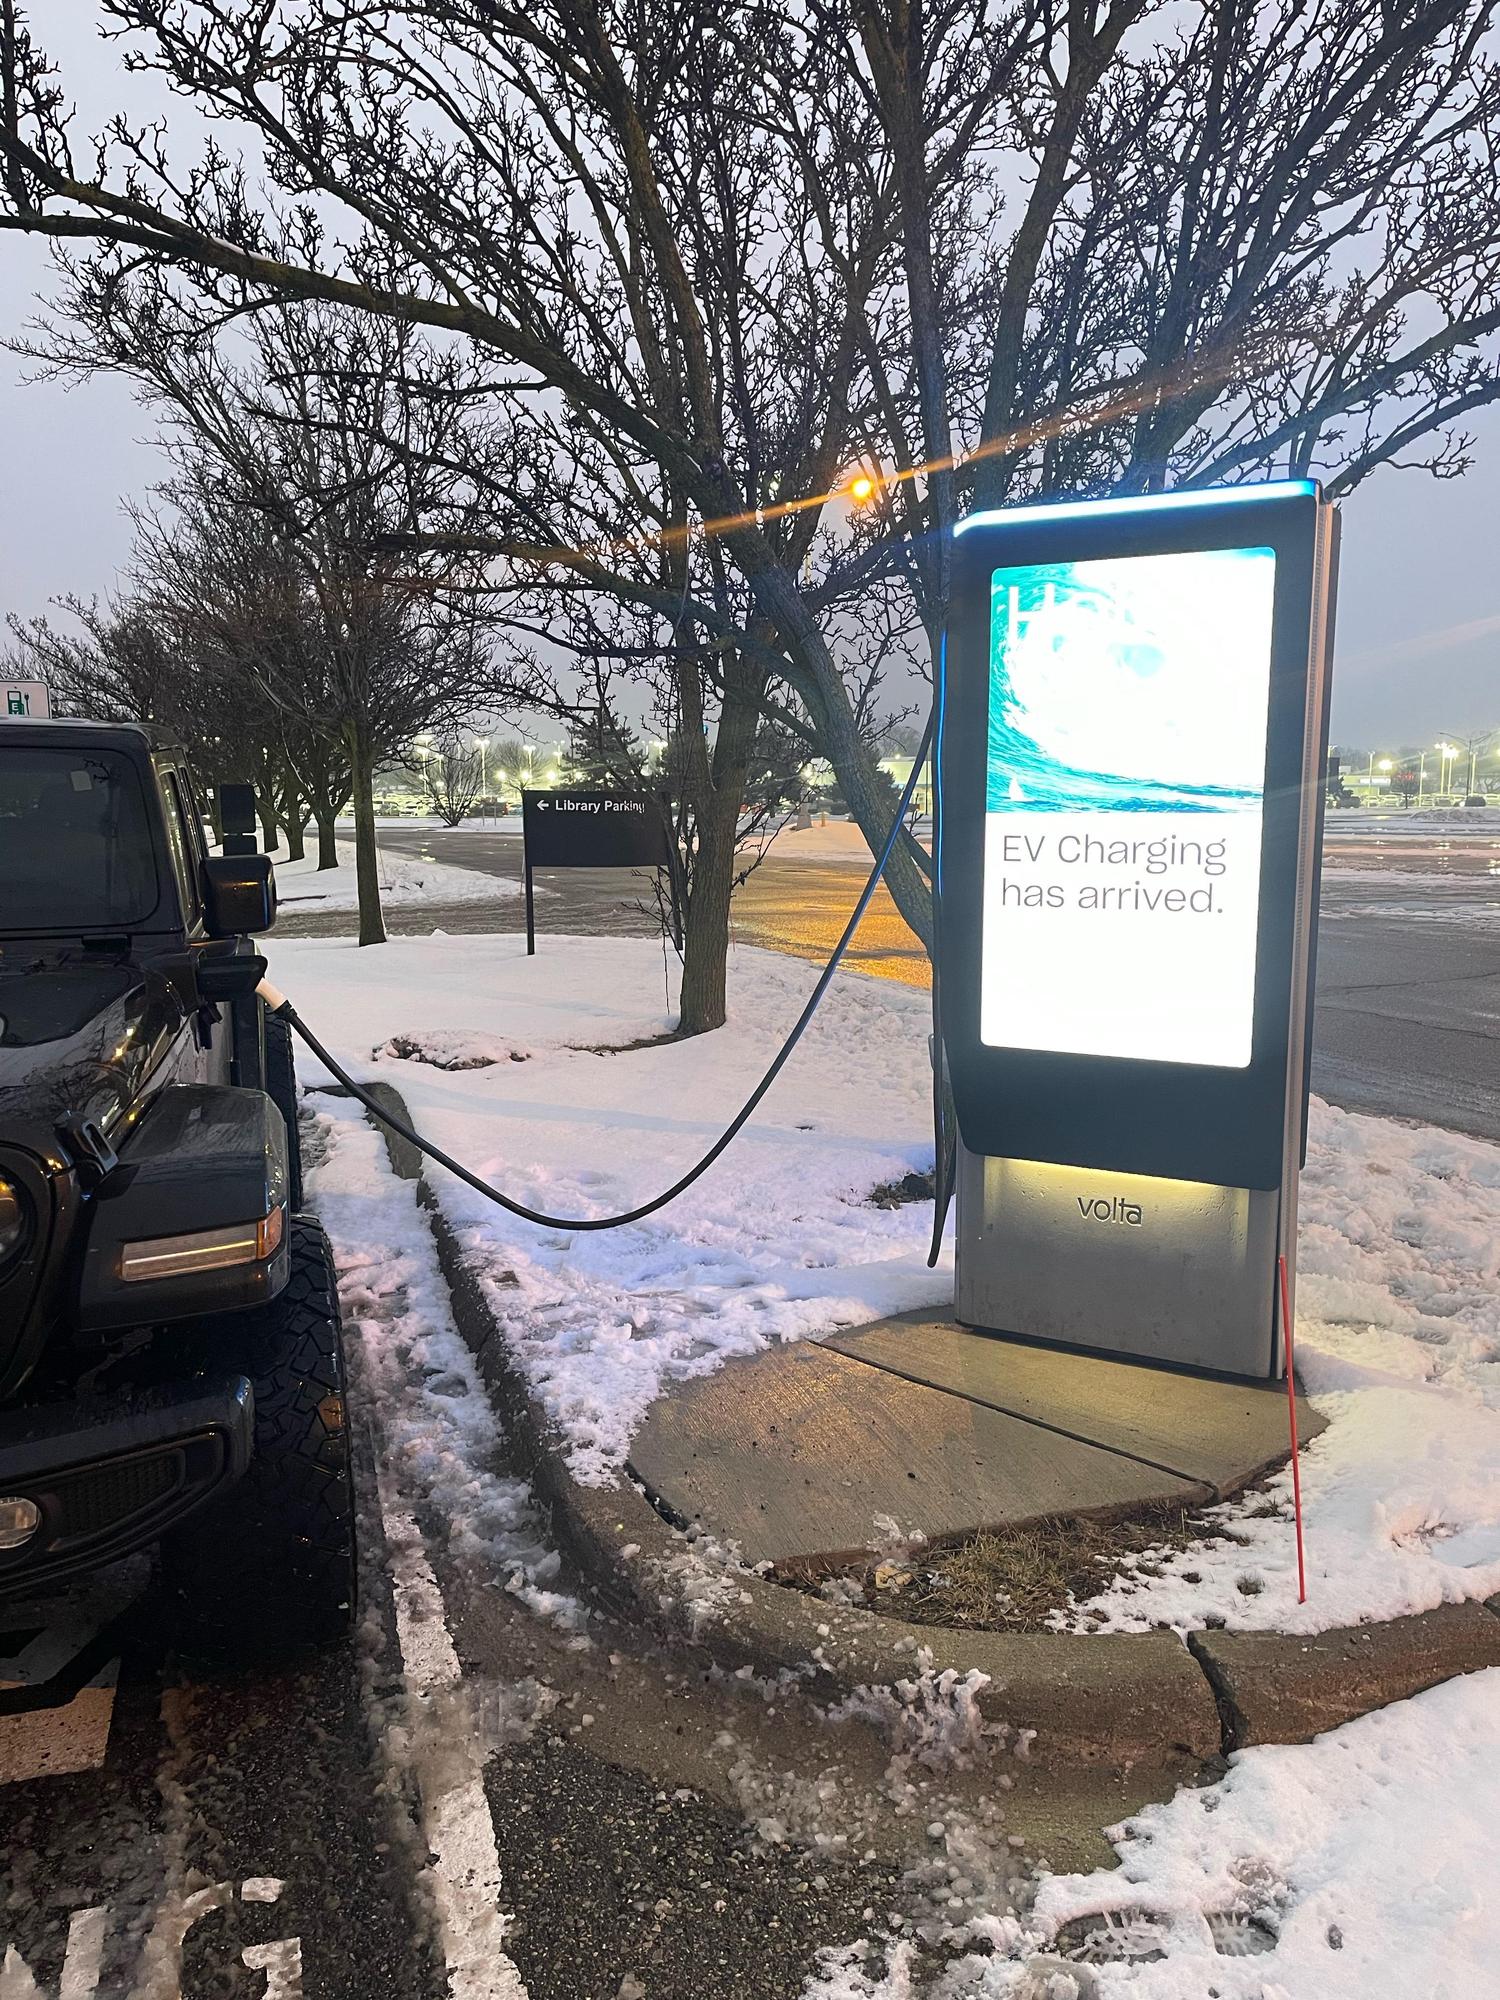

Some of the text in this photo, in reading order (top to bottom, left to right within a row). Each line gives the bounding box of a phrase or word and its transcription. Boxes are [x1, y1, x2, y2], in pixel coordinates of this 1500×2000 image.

[555, 799, 600, 814] Library
[1003, 833, 1227, 876] EV Charging
[1002, 877, 1223, 913] has arrived.
[1077, 1196, 1143, 1227] volta
